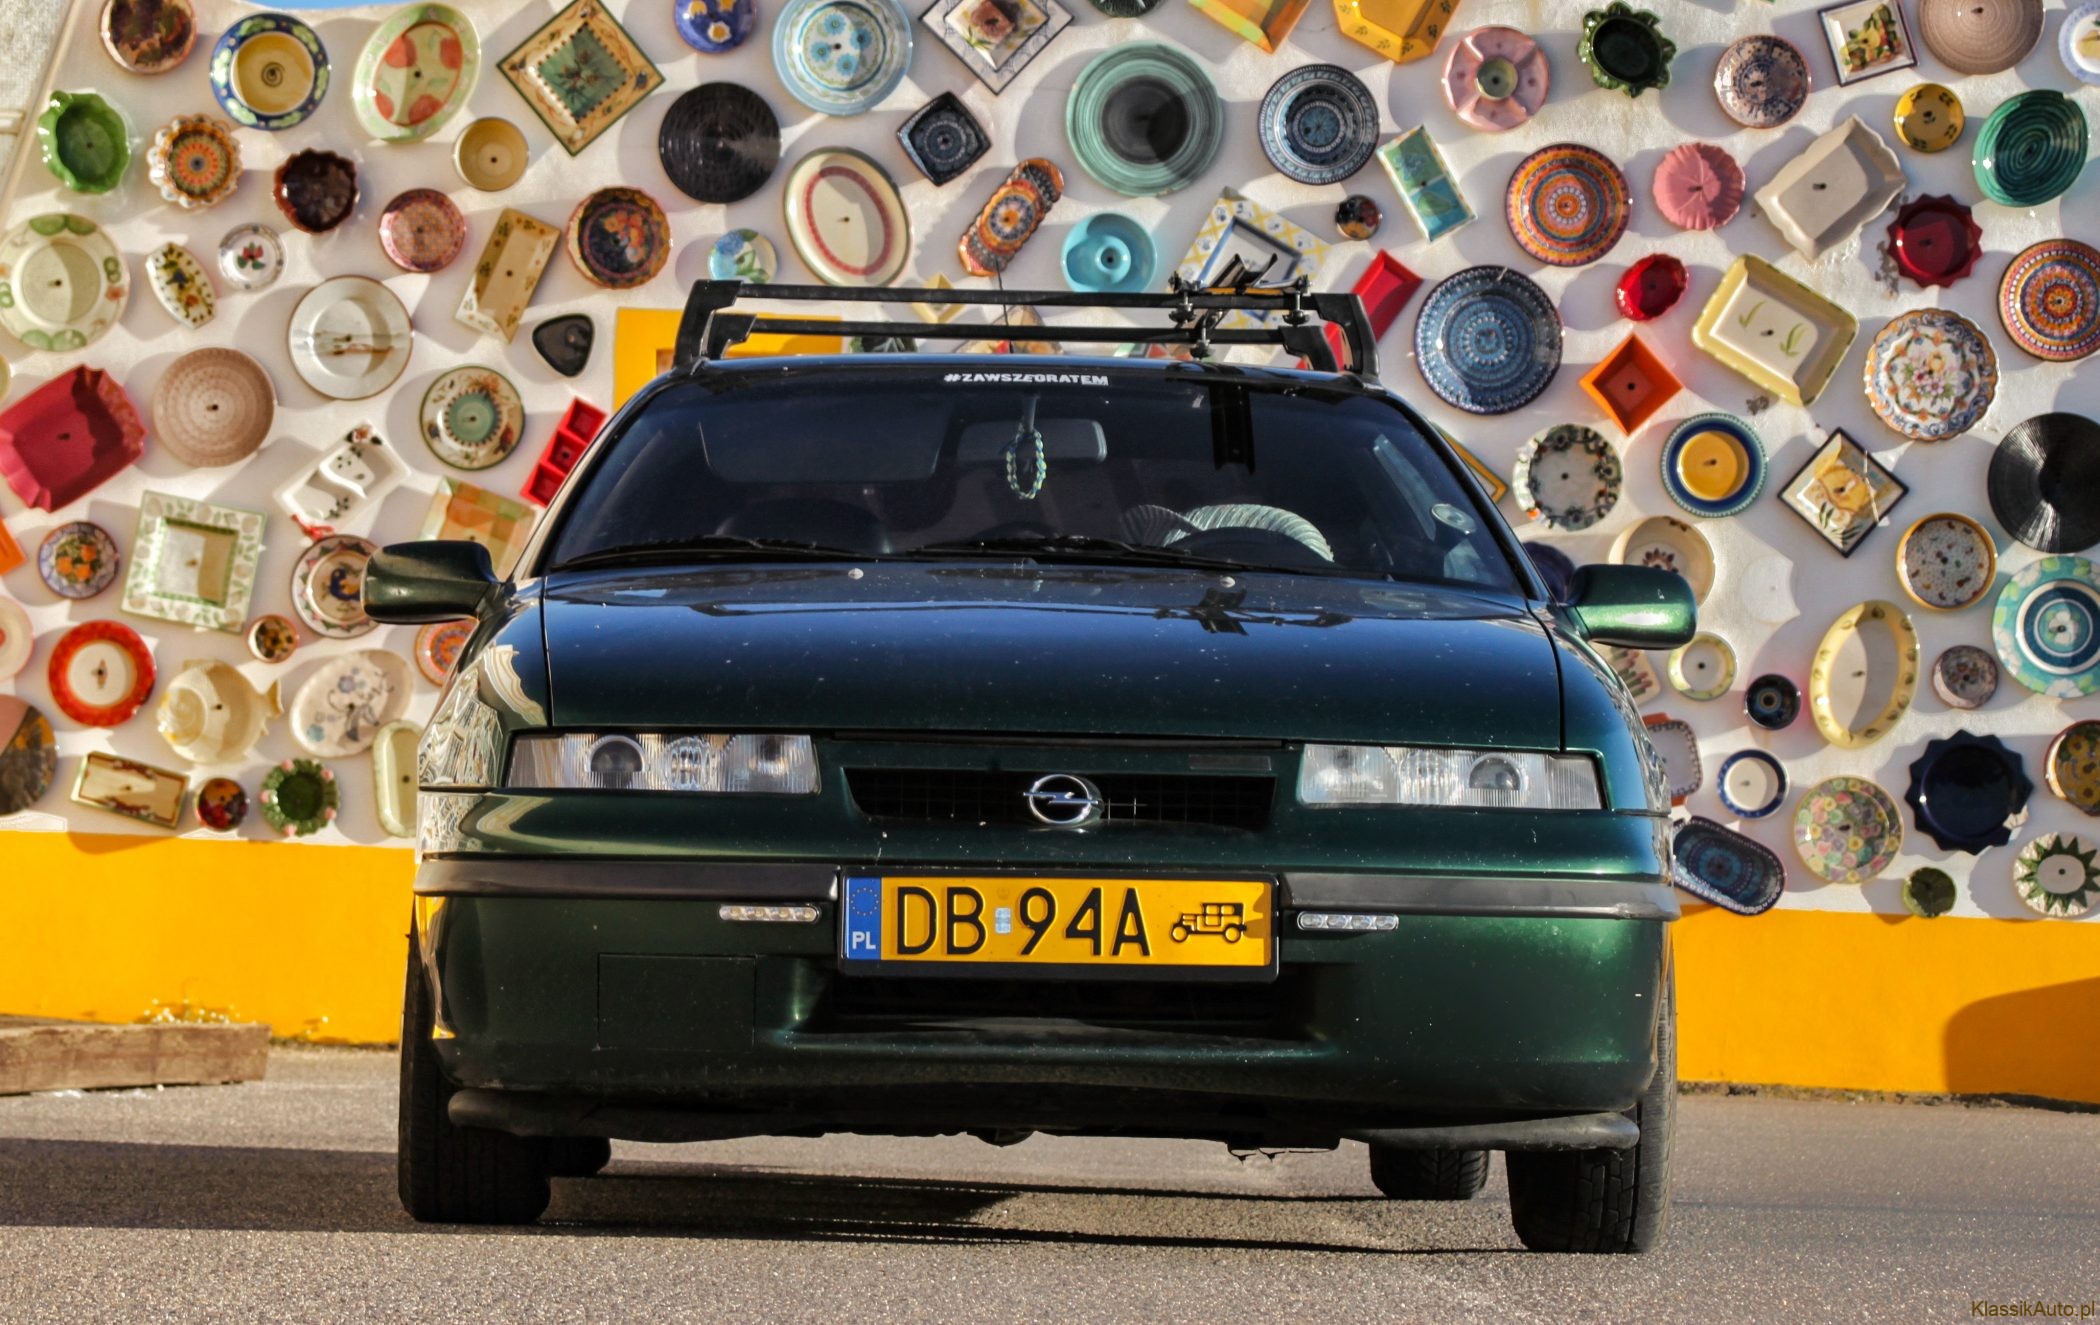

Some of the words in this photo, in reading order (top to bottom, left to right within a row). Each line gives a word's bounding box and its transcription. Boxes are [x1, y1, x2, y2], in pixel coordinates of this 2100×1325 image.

[944, 373, 1109, 386] #ZAWSZEGRATEM
[896, 886, 987, 955] DB
[1019, 887, 1151, 957] 94A
[852, 931, 877, 950] PL
